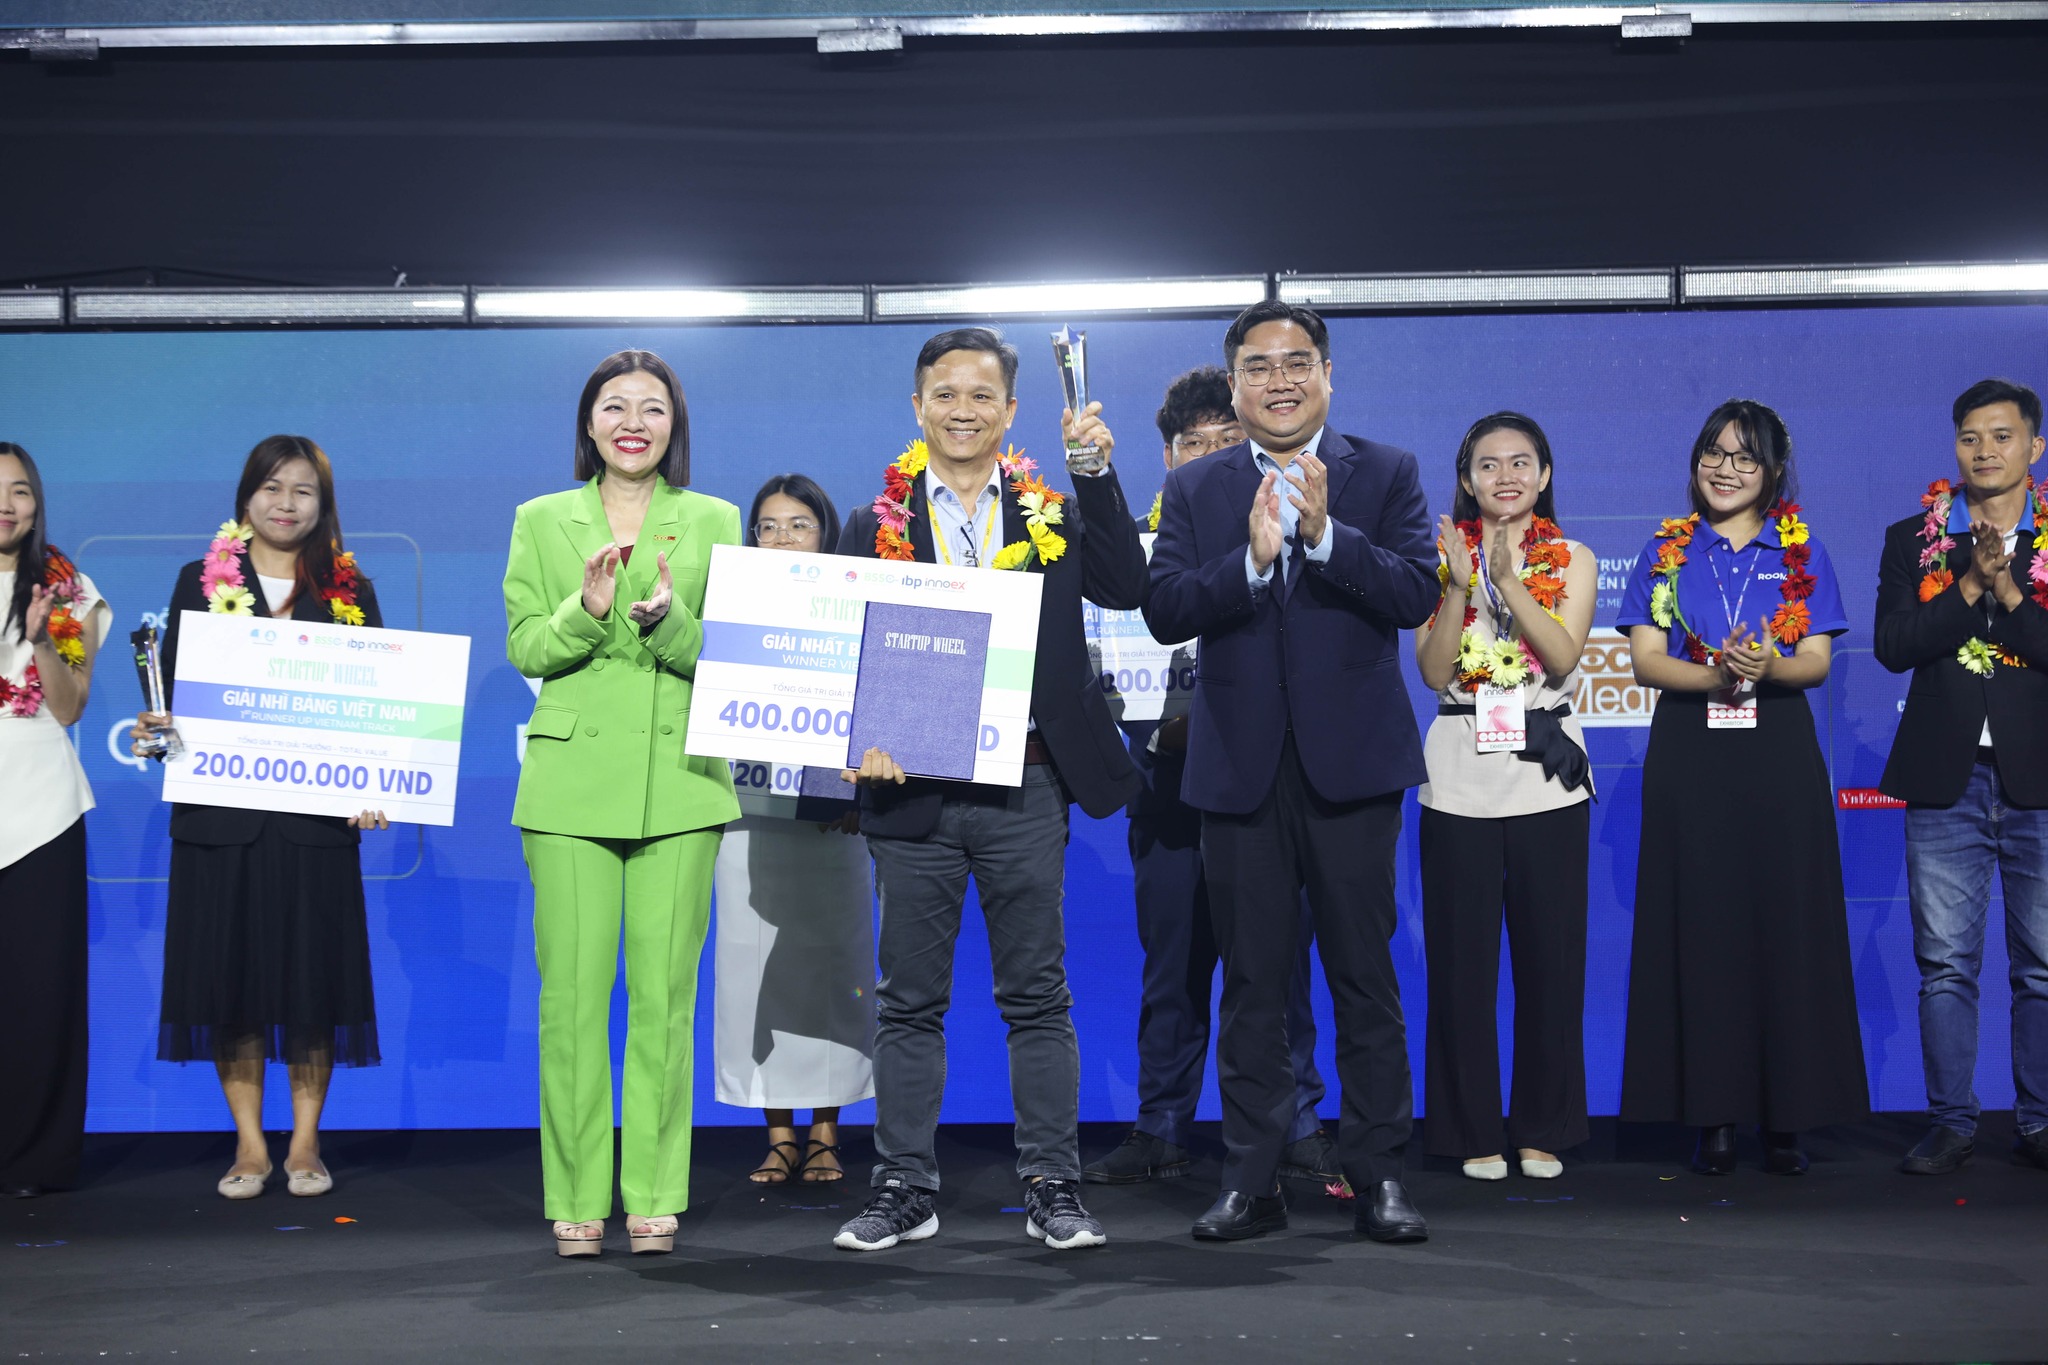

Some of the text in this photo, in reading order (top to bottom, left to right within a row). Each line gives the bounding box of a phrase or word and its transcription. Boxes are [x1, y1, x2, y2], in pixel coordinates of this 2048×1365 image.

[901, 575, 923, 589] ibp
[924, 577, 966, 590] innoex
[1096, 626, 1140, 635] RUNNER
[762, 632, 797, 651] GIẢI
[801, 635, 845, 656] NHẤT
[884, 631, 931, 652] STARTUP
[933, 636, 966, 655] WHEEL
[267, 657, 330, 682] STARTUP
[782, 654, 837, 668] WINNER
[222, 688, 417, 722] GIẢI NHÌ BẢNG VIỆT NAM
[251, 711, 296, 724] RUNNER
[298, 716, 313, 725] UP
[315, 718, 361, 730] VIETNAM
[362, 721, 396, 733] TRACK
[193, 751, 433, 796] 200.000.000 VND
